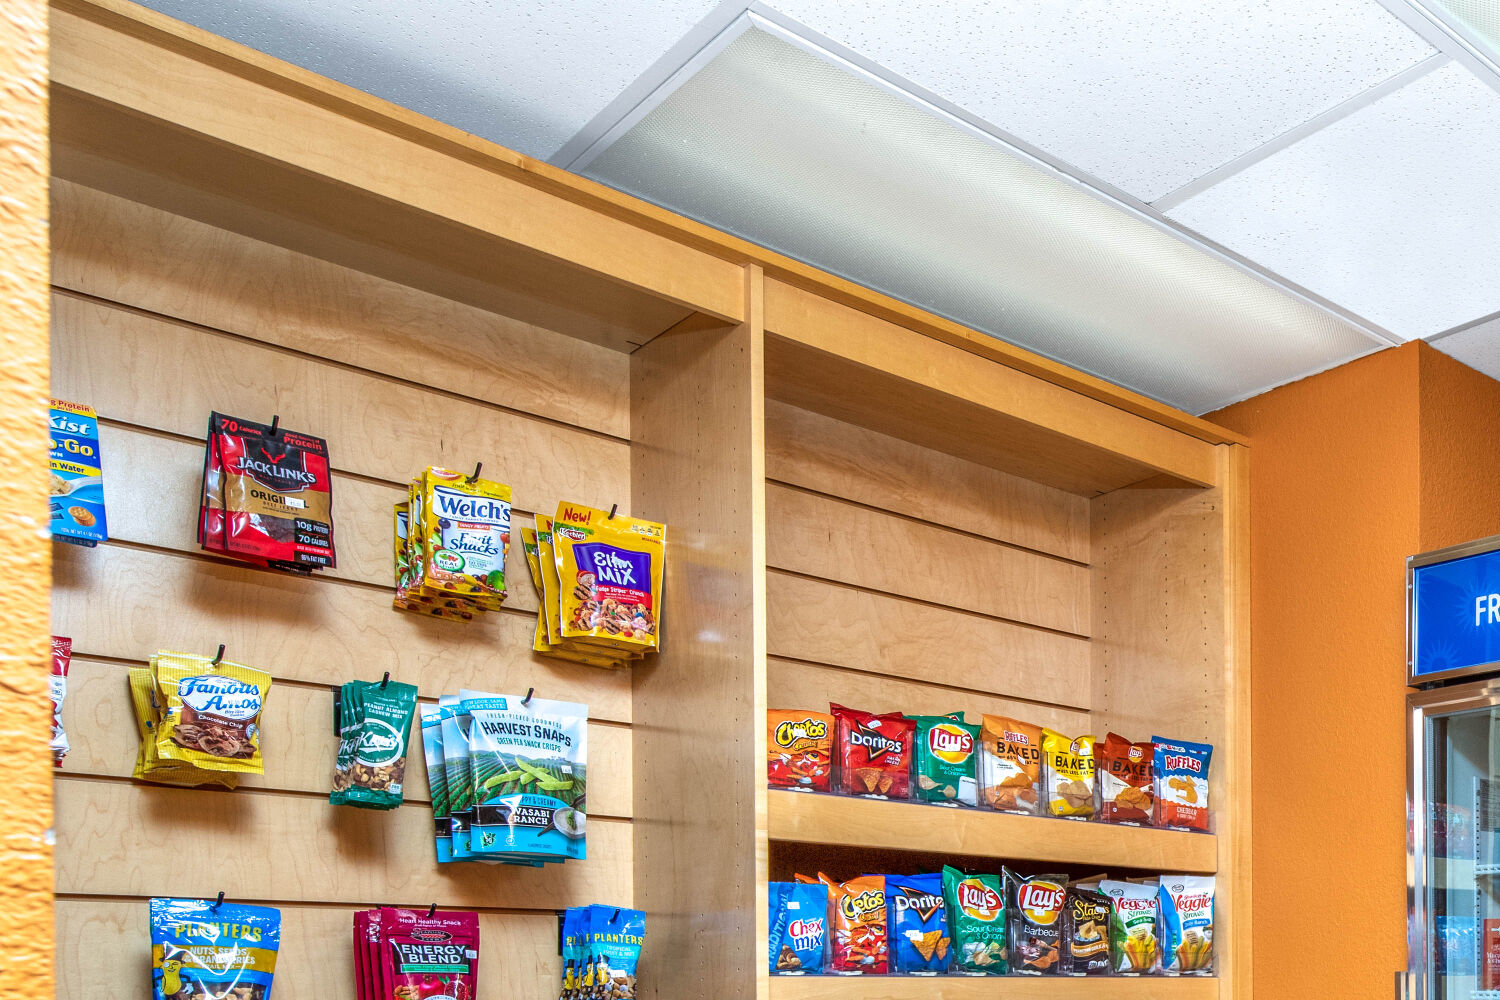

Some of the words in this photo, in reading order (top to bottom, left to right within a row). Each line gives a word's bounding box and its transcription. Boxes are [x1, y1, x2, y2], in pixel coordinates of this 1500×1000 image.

[221, 419, 238, 433] 70
[59, 462, 84, 474] Water
[237, 456, 271, 478] JACK
[270, 466, 316, 483] LINK'S
[438, 496, 510, 521] Welch's
[563, 508, 591, 525] New!
[450, 540, 498, 555] Snacks
[178, 676, 260, 696] Famous
[481, 721, 532, 737] HARVEST
[535, 725, 572, 747] SNAPS
[851, 732, 902, 753] Doritos
[933, 729, 971, 751] Lay's
[497, 737, 513, 746] GREEN
[524, 740, 541, 749] SNACK
[996, 742, 1039, 760] BAKED
[1055, 756, 1094, 769] BAKED
[1112, 760, 1153, 776] BAKED
[1166, 756, 1201, 771] RUFFLES
[514, 815, 548, 825] RANCH
[896, 896, 945, 910] Dorito
[964, 890, 997, 911] Lay's
[1025, 885, 1065, 910] Lay's
[1113, 897, 1156, 914] Veggie
[1176, 896, 1213, 914] Veggie
[789, 918, 824, 937] Chex
[1024, 925, 1058, 937] Barbecue
[594, 934, 643, 946] PLANTERS
[795, 934, 822, 951] mix
[402, 945, 466, 955] ENERGY
[409, 954, 461, 964] BLEND
